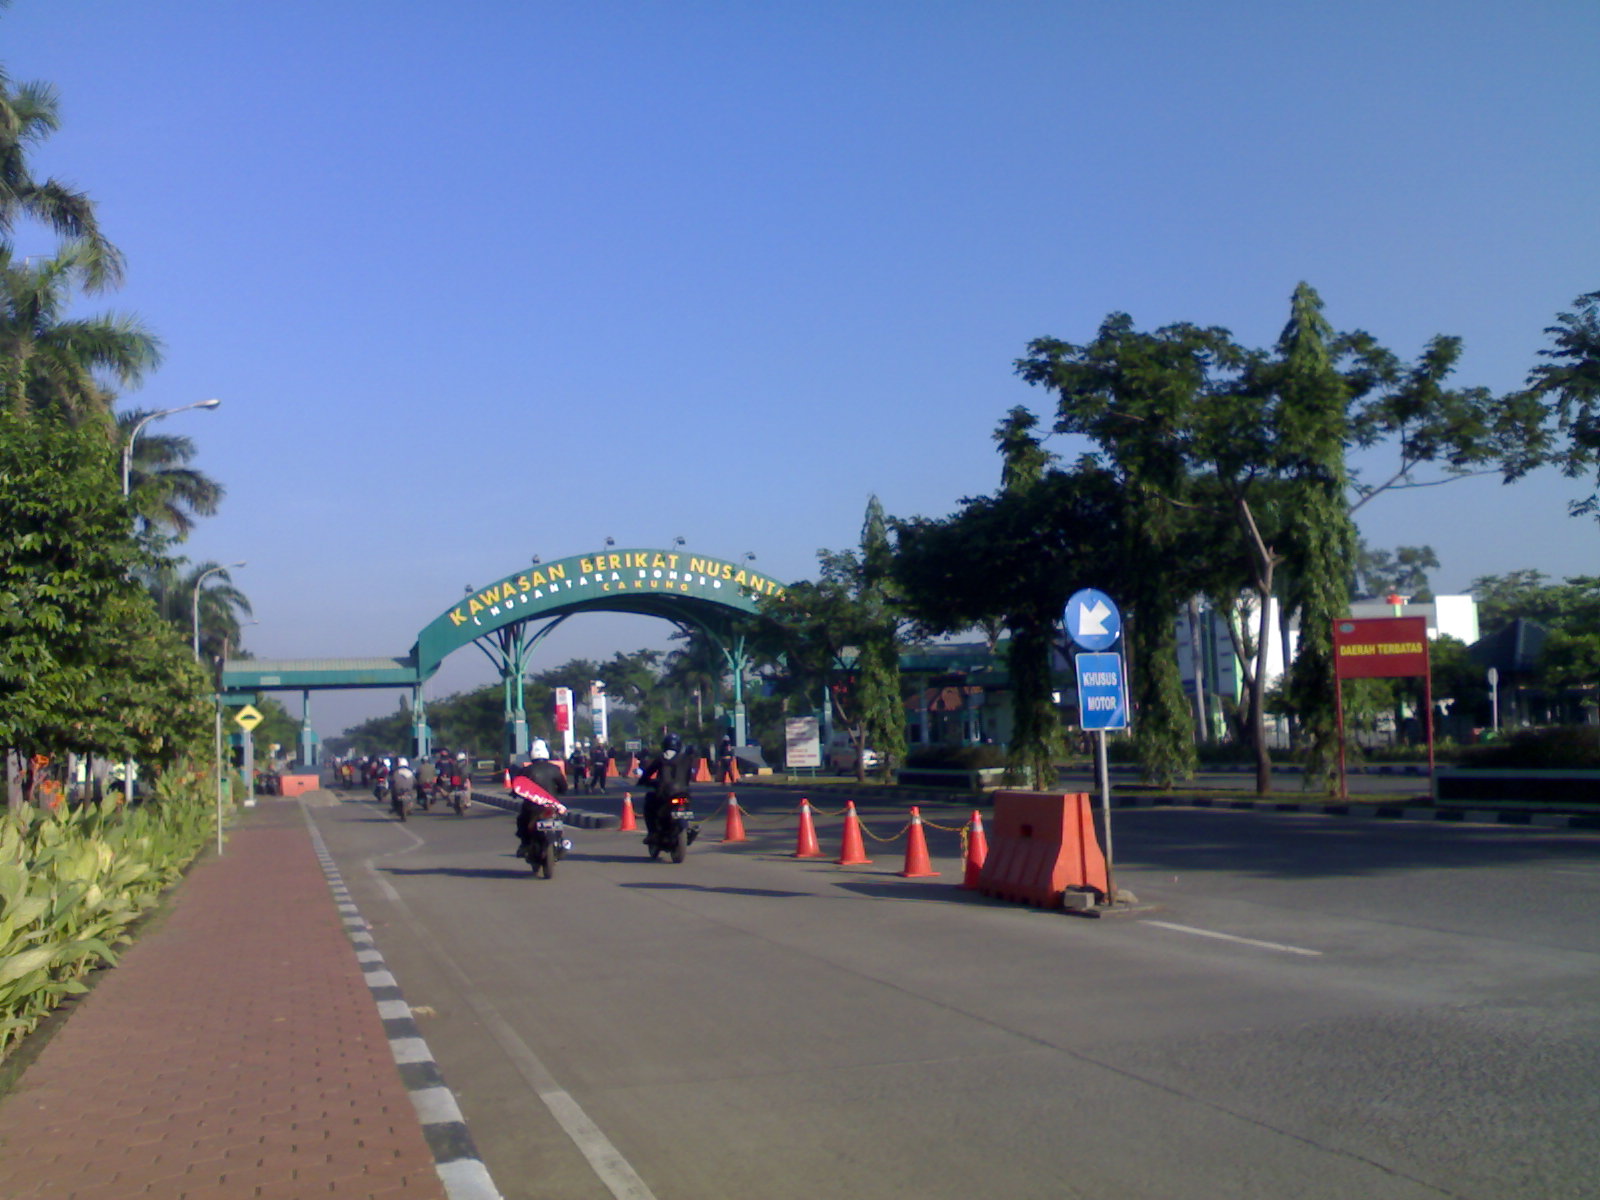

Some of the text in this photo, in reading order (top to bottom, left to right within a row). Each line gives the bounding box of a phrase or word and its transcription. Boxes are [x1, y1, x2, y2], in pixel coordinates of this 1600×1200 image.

[603, 580, 689, 592] CAKUNG
[638, 569, 722, 589] BONDED
[449, 564, 566, 626] KAWASAN
[580, 553, 679, 574] BERIKAT
[1340, 642, 1423, 656] DAERAH TERBATAS
[1082, 671, 1117, 686] KHUSUS
[1087, 695, 1116, 711] MOTOR
